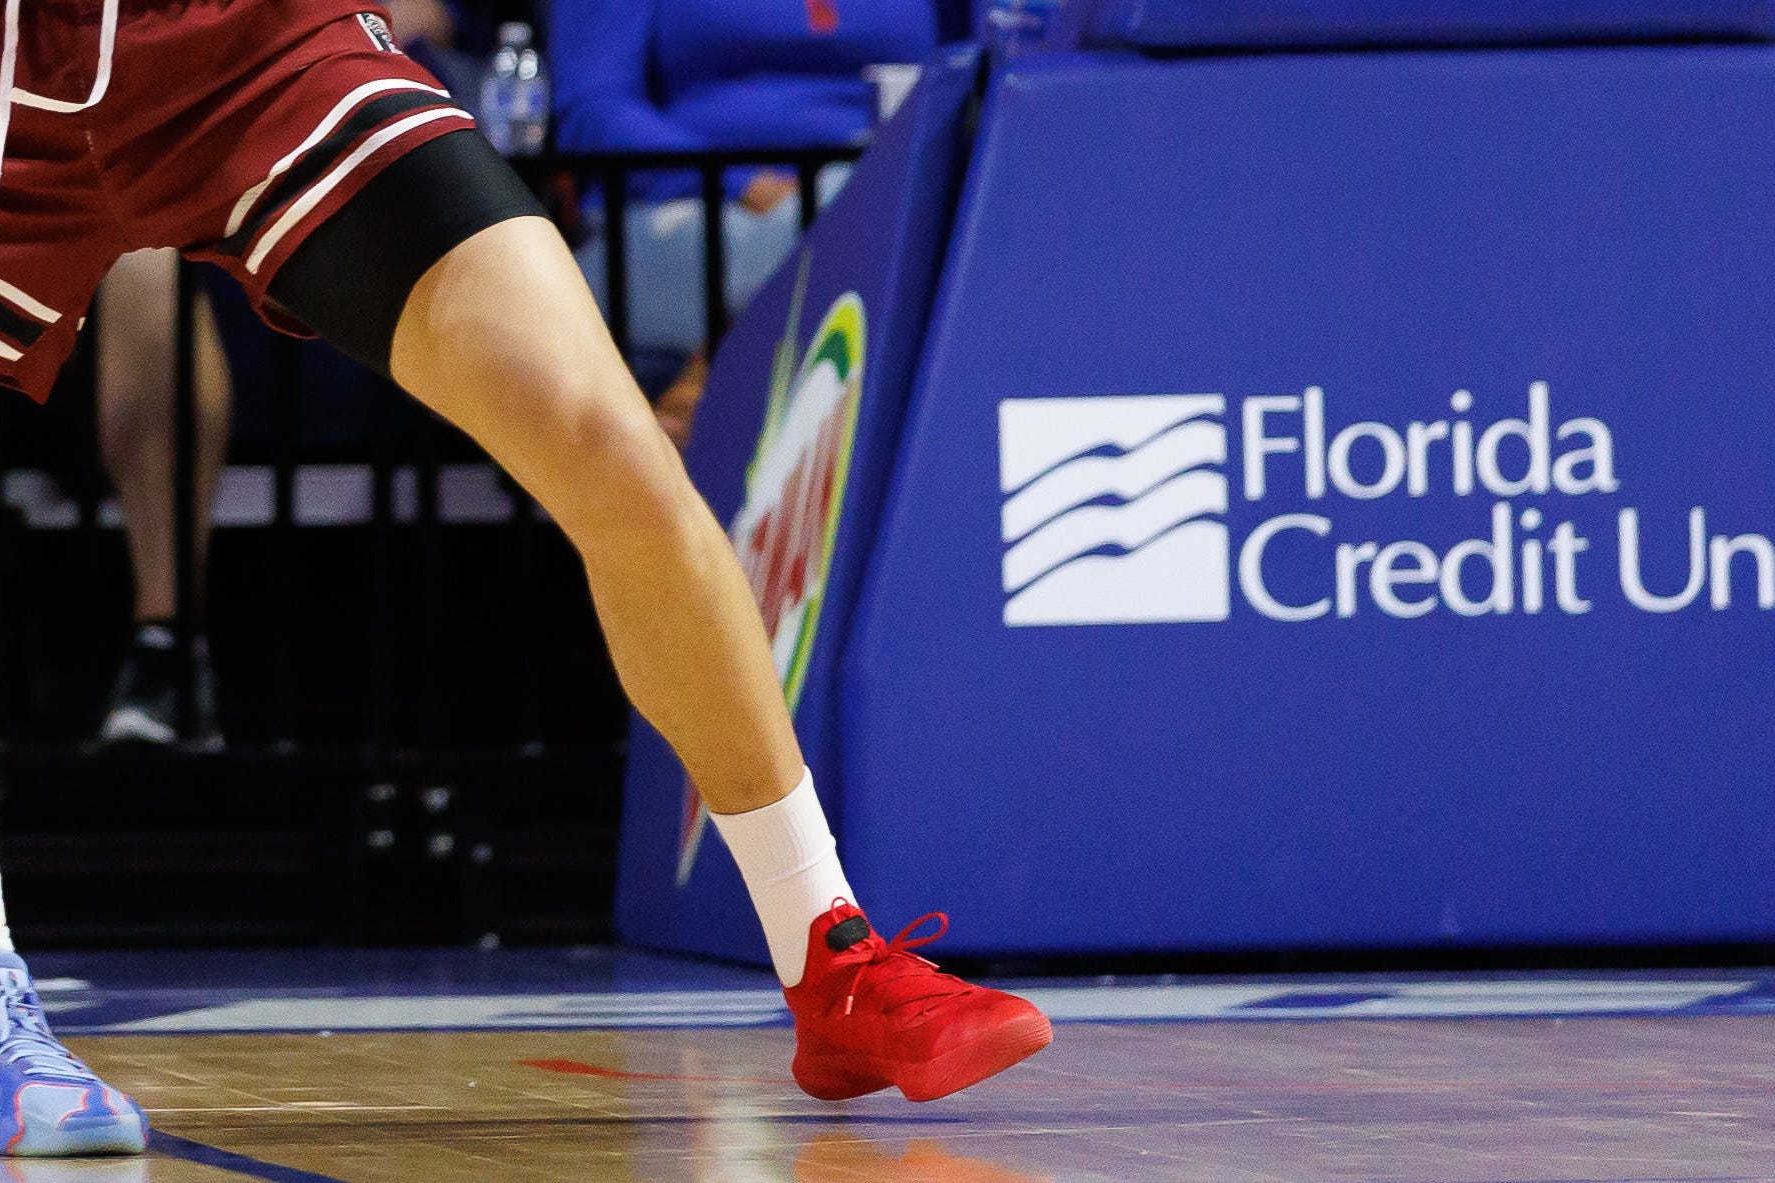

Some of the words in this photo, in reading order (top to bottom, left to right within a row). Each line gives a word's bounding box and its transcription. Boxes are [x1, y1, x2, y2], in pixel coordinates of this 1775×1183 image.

[1242, 380, 1620, 501] Florida
[1238, 502, 1592, 622] Credit
[1618, 505, 1775, 613] Un
